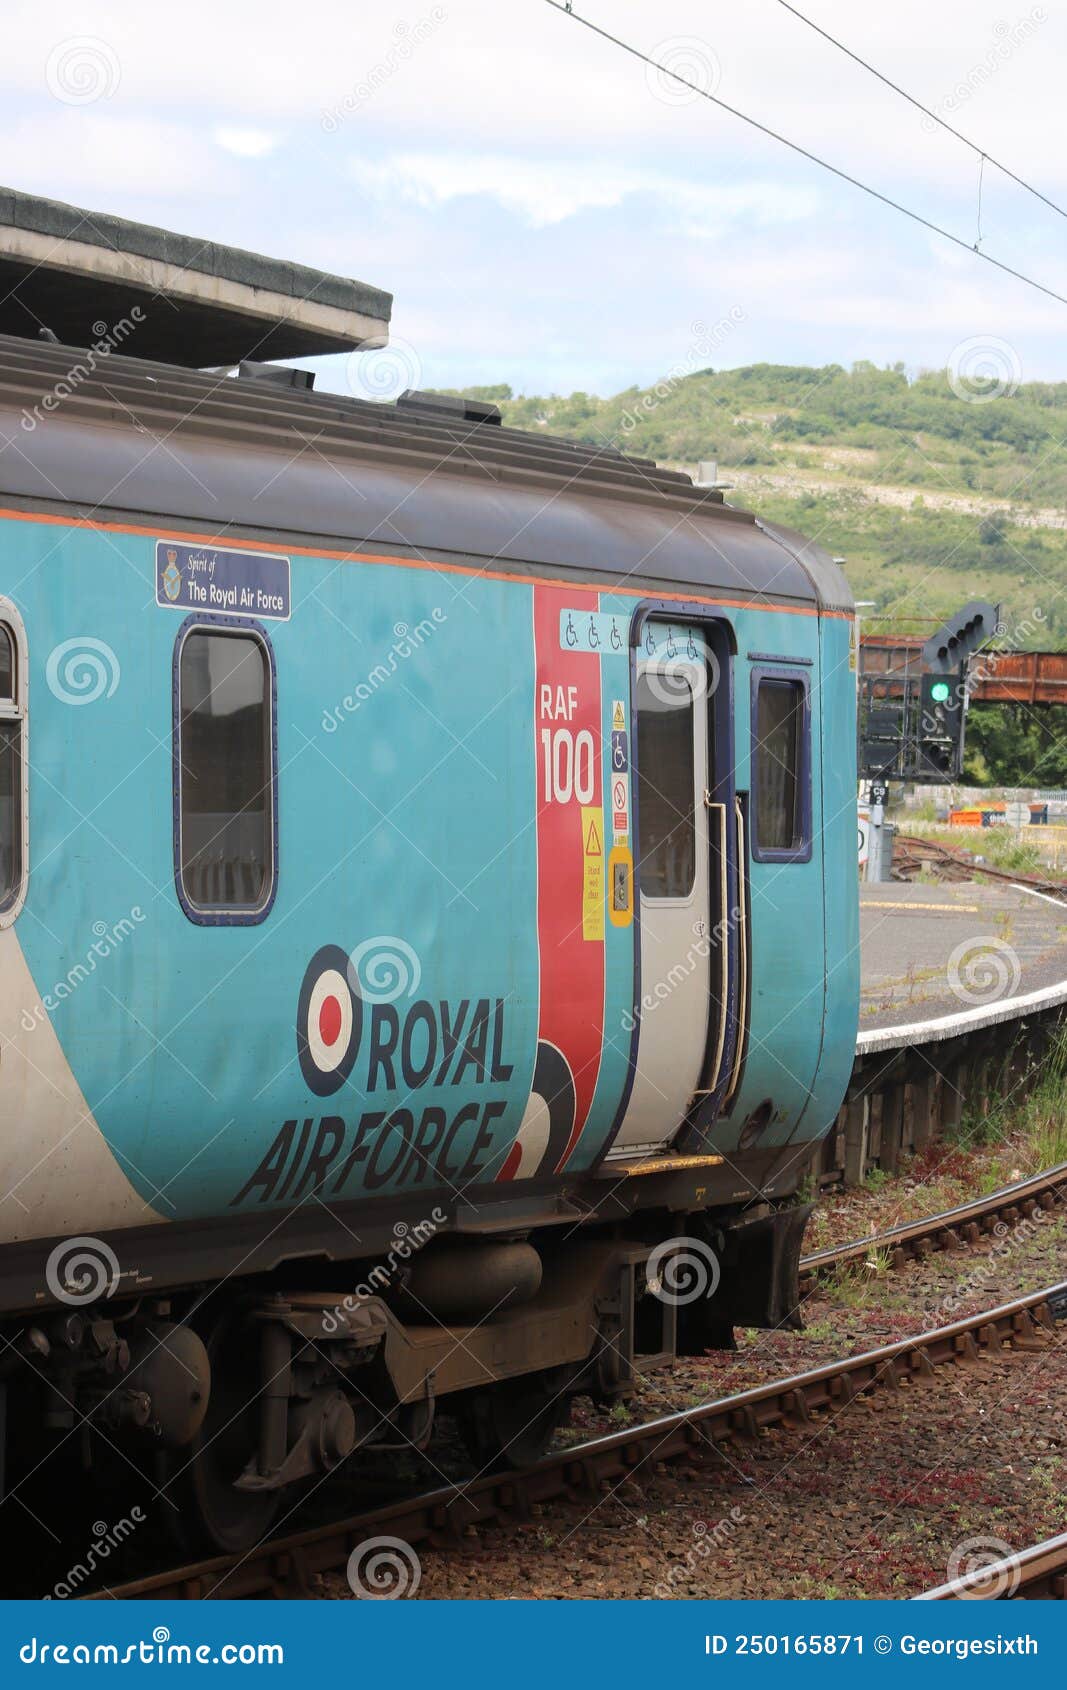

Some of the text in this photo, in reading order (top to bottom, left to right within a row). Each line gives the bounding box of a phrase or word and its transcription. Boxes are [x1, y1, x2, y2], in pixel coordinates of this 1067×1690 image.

[188, 553, 217, 581] Spirit of
[188, 581, 284, 611] The Royal Air Force
[541, 684, 578, 721] RAF
[541, 728, 595, 805] 100
[366, 998, 515, 1092] ROYAL
